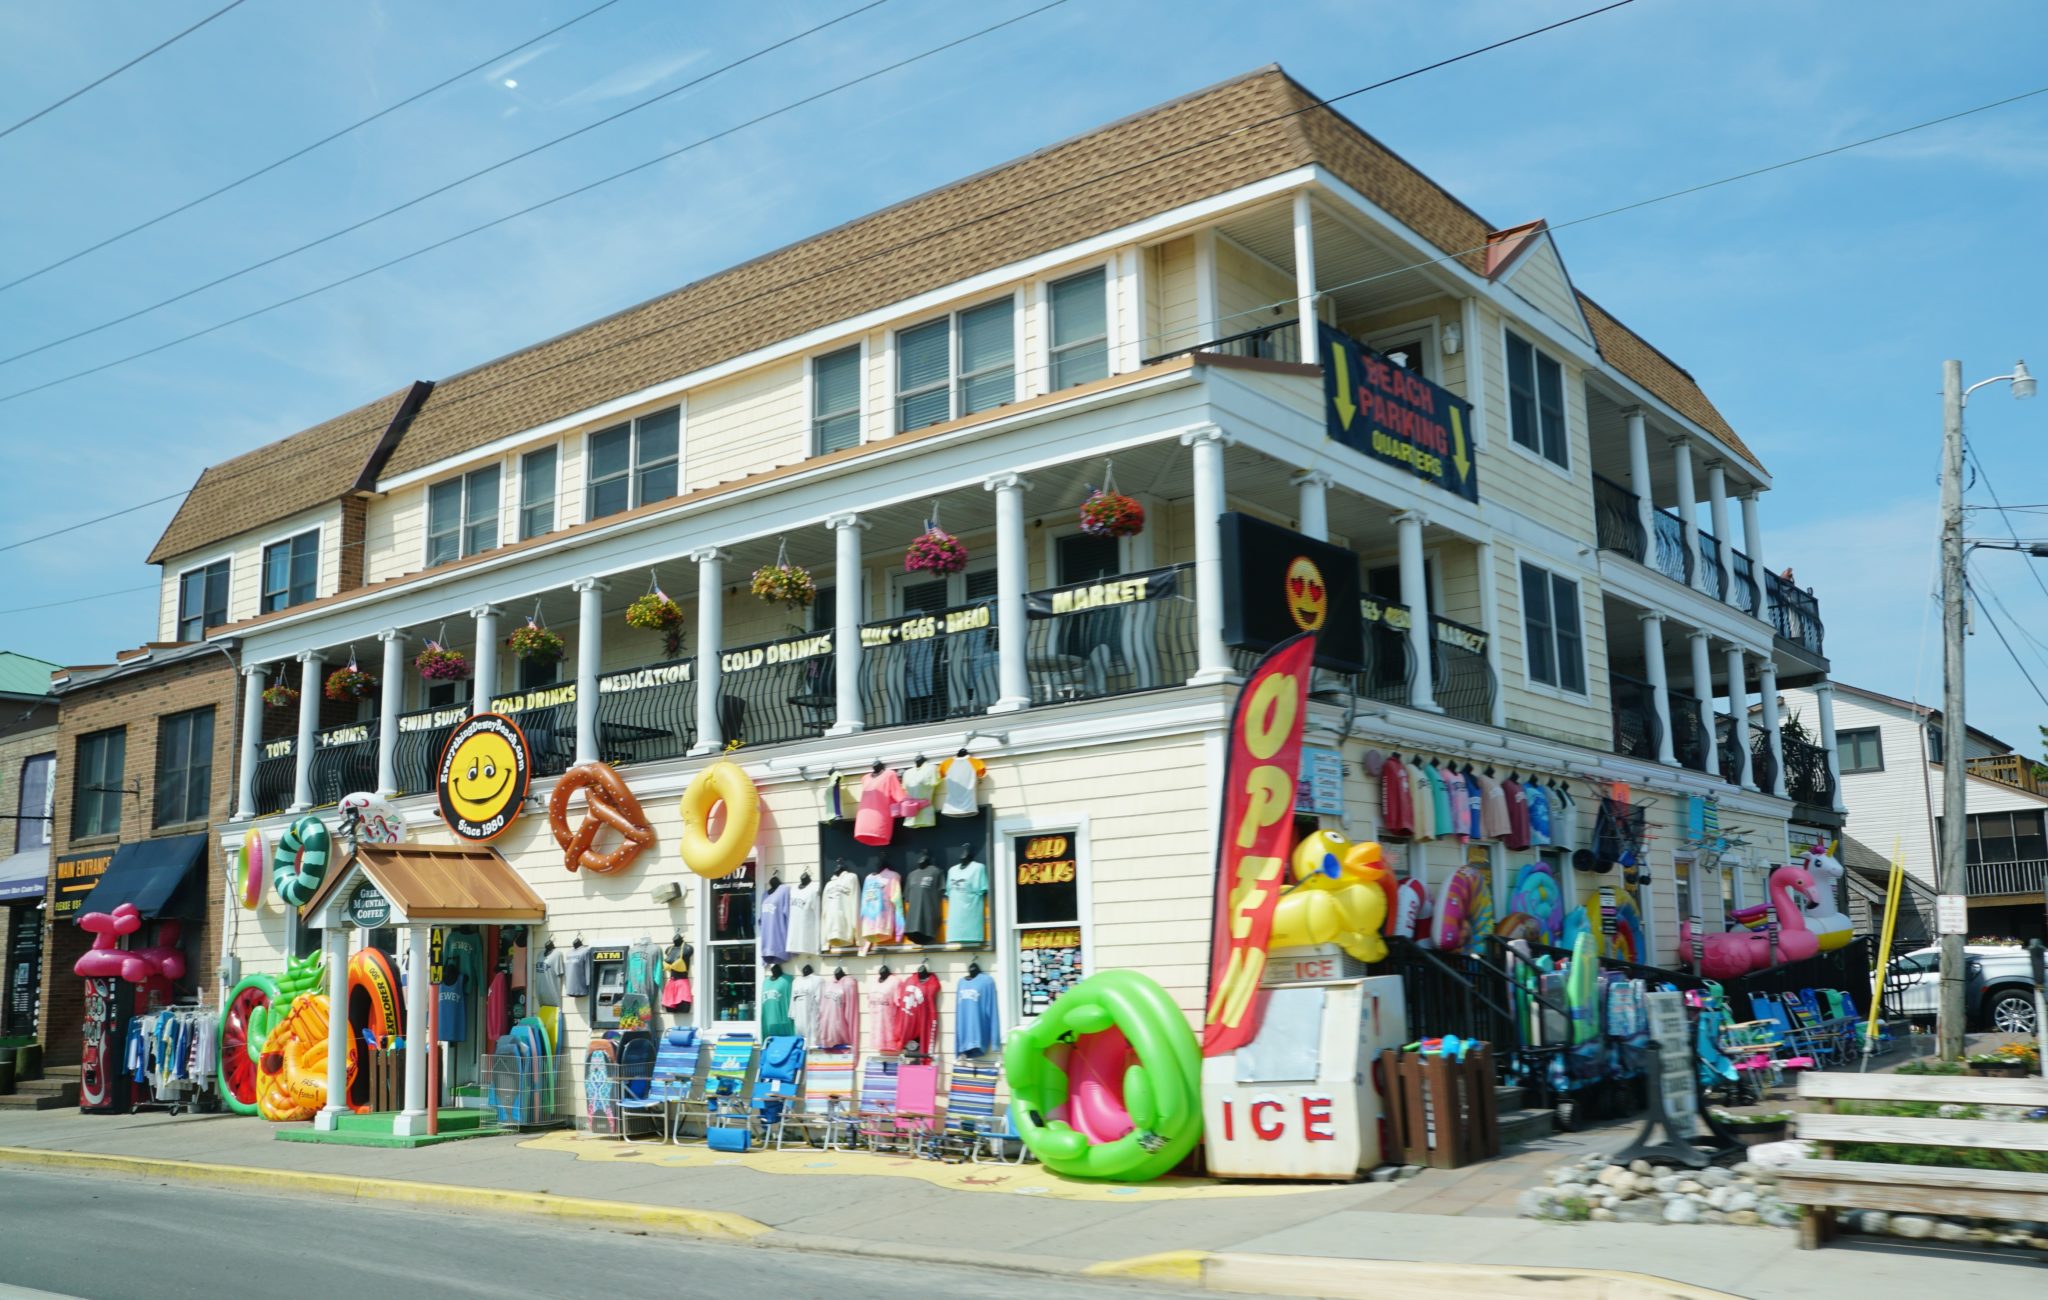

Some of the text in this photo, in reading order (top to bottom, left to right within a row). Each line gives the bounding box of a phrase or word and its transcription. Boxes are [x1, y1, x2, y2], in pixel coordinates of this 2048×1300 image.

[1362, 355, 1434, 415] BEACH
[1359, 385, 1449, 456] PARKING
[1372, 430, 1442, 477] QUARTERS
[1052, 577, 1149, 614] MARKET
[902, 617, 935, 641] EGGS
[946, 607, 989, 633] BREAD
[721, 634, 832, 673] COLD DRINKS
[599, 664, 690, 693] MEDICATION
[491, 684, 576, 714] COLD DRINKS
[400, 706, 467, 732] SWIM SUITS
[265, 739, 291, 758] TOYS
[440, 719, 524, 783] EverythingDeweyBeach.com
[458, 814, 504, 836] Since 1980
[1207, 672, 1298, 1028] OPEN
[57, 862, 75, 879] MAIN
[357, 909, 384, 919] COFFEE
[431, 928, 443, 984] ATM
[595, 951, 621, 959] ATM
[1295, 960, 1334, 978] ICE
[369, 967, 380, 980] 300
[376, 982, 395, 1035] EXPLORER
[1221, 1091, 1335, 1143] ICE
